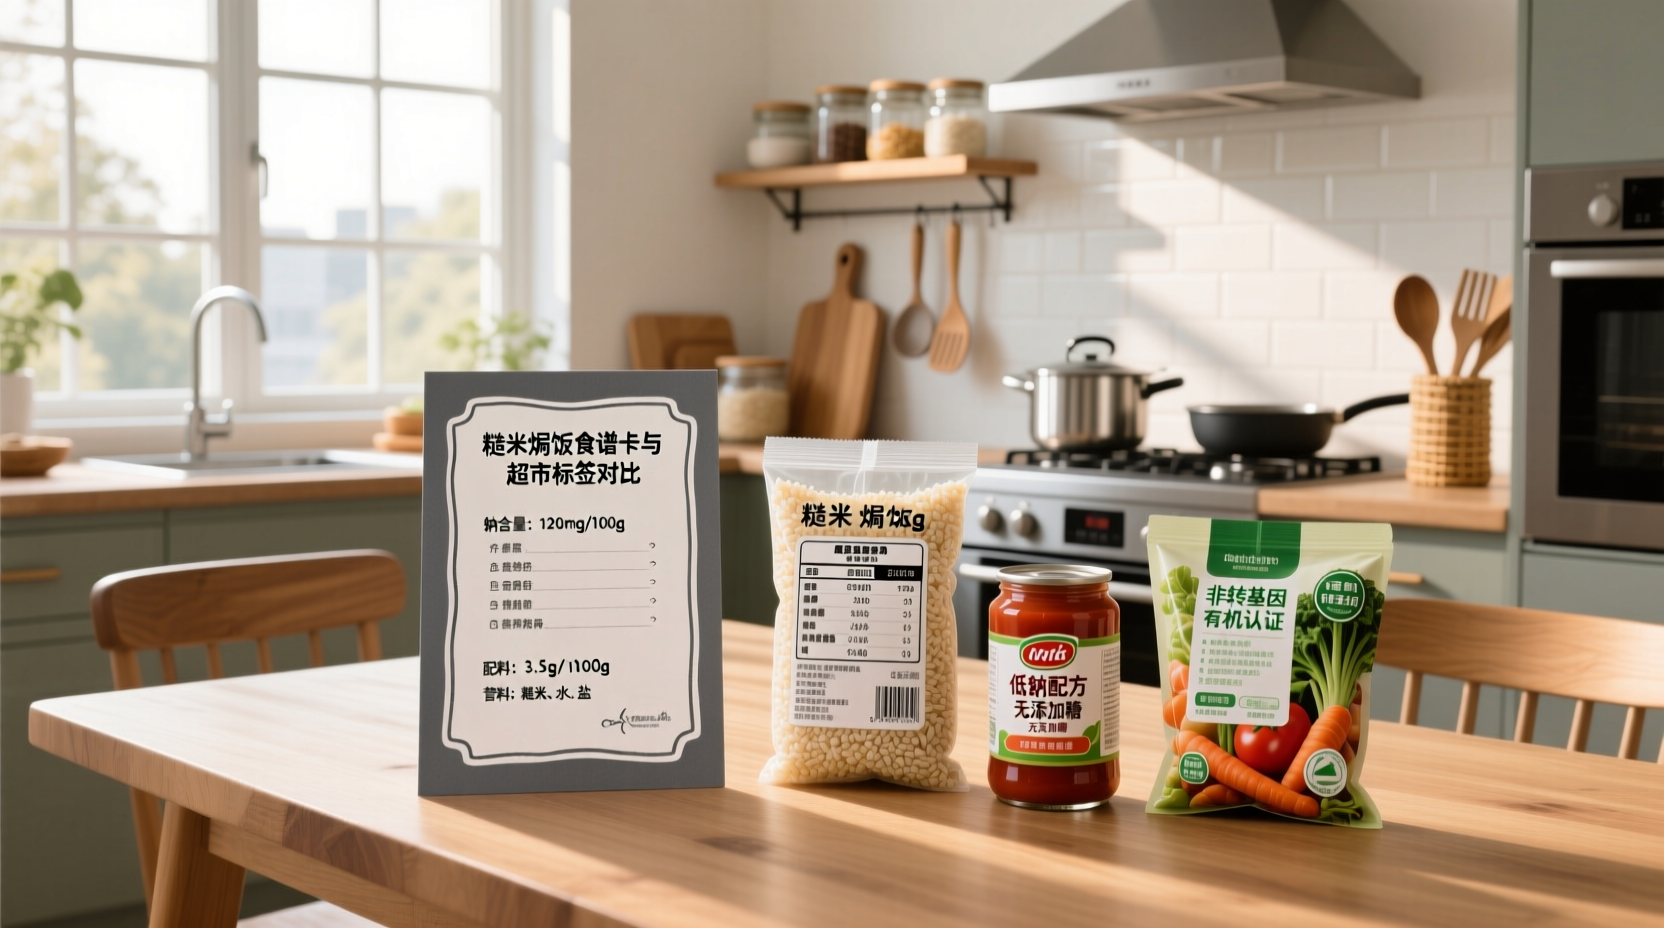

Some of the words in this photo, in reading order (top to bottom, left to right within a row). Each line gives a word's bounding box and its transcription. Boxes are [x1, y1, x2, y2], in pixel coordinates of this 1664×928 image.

[482, 431, 662, 457] 糙米焗饭食谱卡与
[506, 460, 641, 486] 超市标签对比
[539, 516, 625, 533] 120mg/100g
[801, 502, 853, 528] 糙米
[1205, 584, 1288, 608] 非转基因
[1204, 609, 1285, 631] 有机认证
